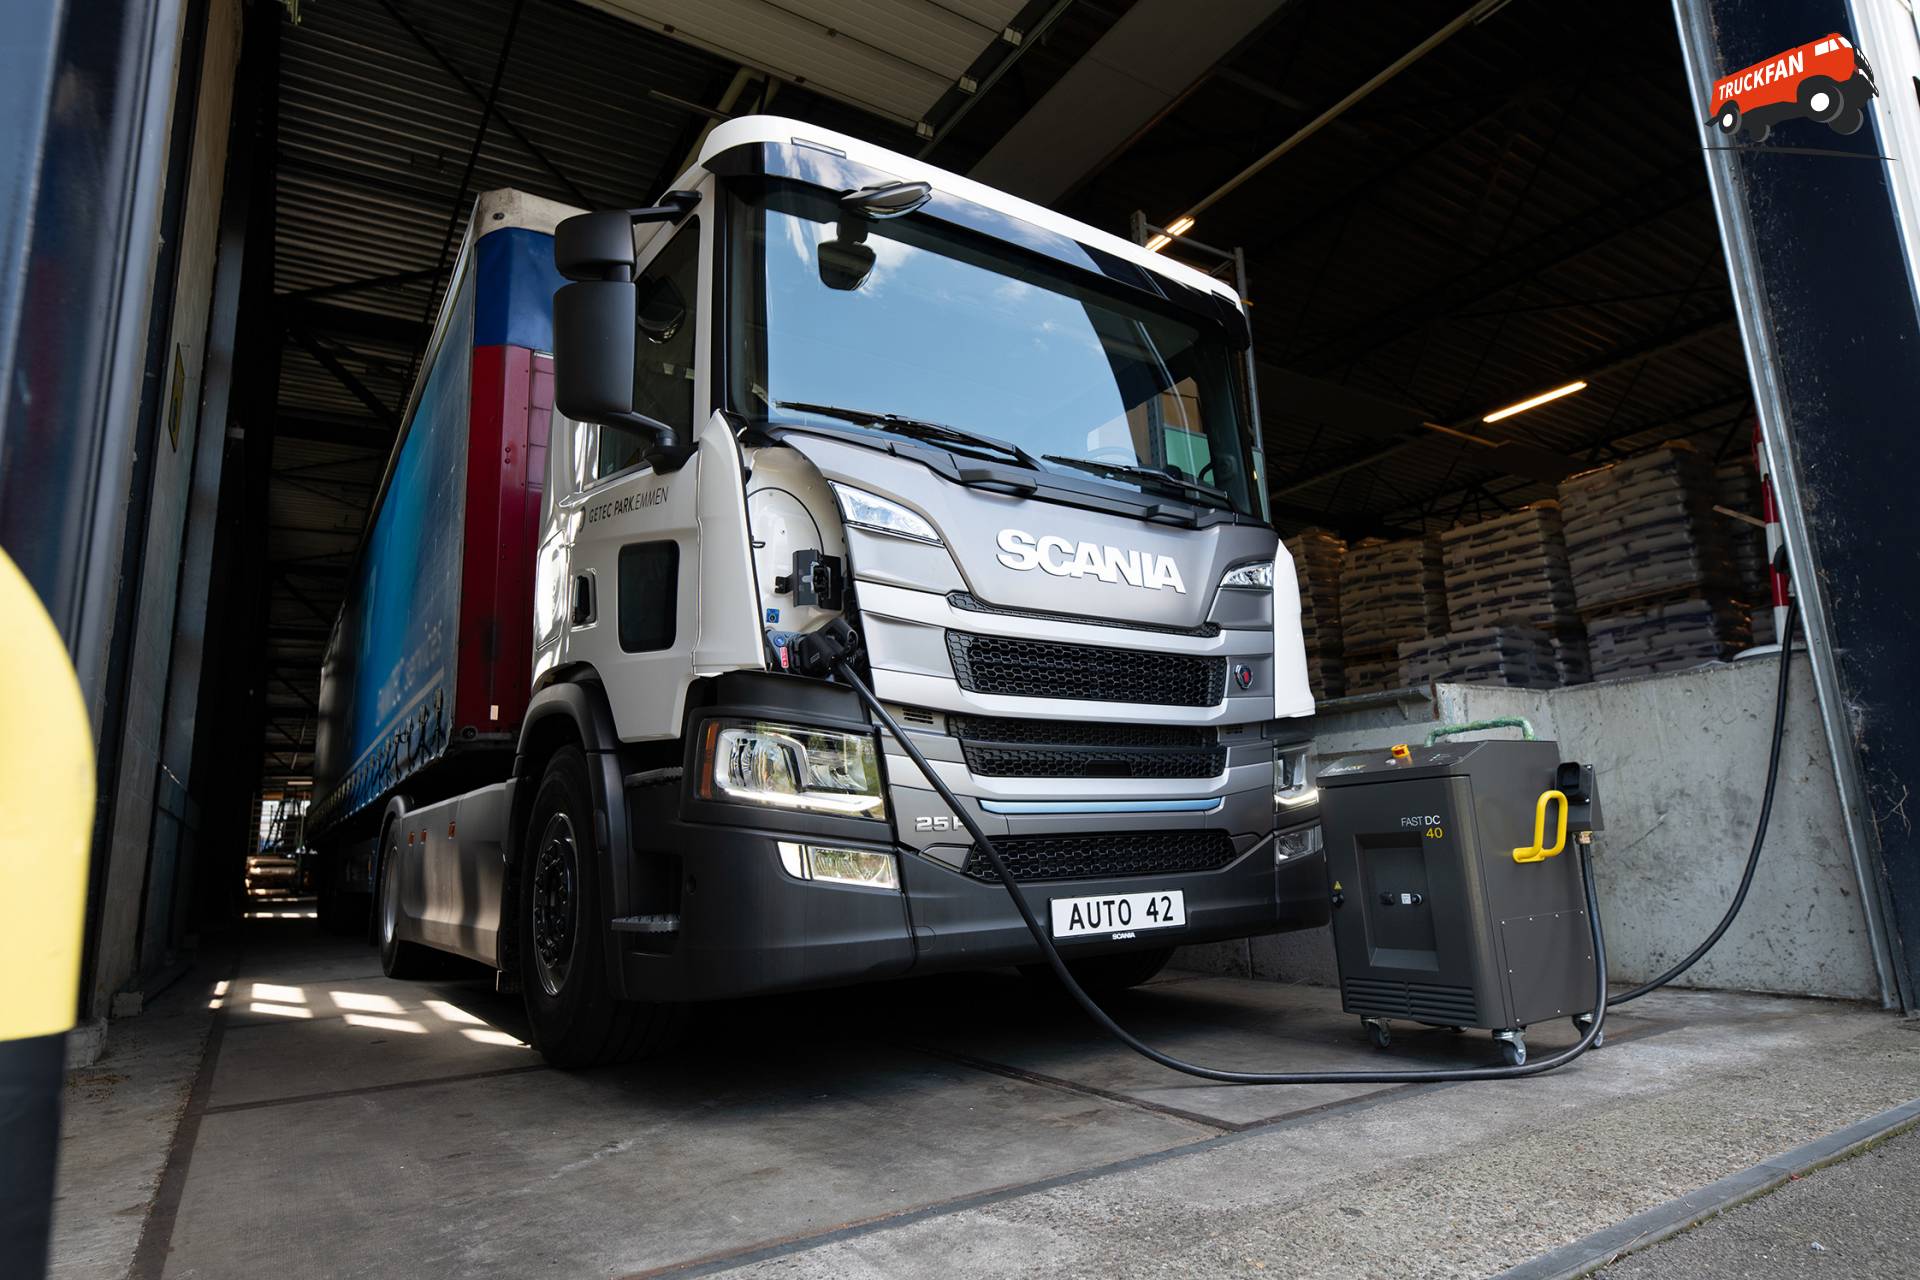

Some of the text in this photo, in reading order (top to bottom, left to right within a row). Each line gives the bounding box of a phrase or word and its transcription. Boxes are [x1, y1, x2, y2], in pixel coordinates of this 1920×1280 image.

[588, 503, 612, 524] GETEC
[995, 528, 1187, 595] SCANIA
[1401, 814, 1441, 827] FAST DC
[1425, 827, 1443, 839] 40
[1068, 895, 1174, 931] AUTO 42
[1111, 931, 1136, 941] SCANIA
